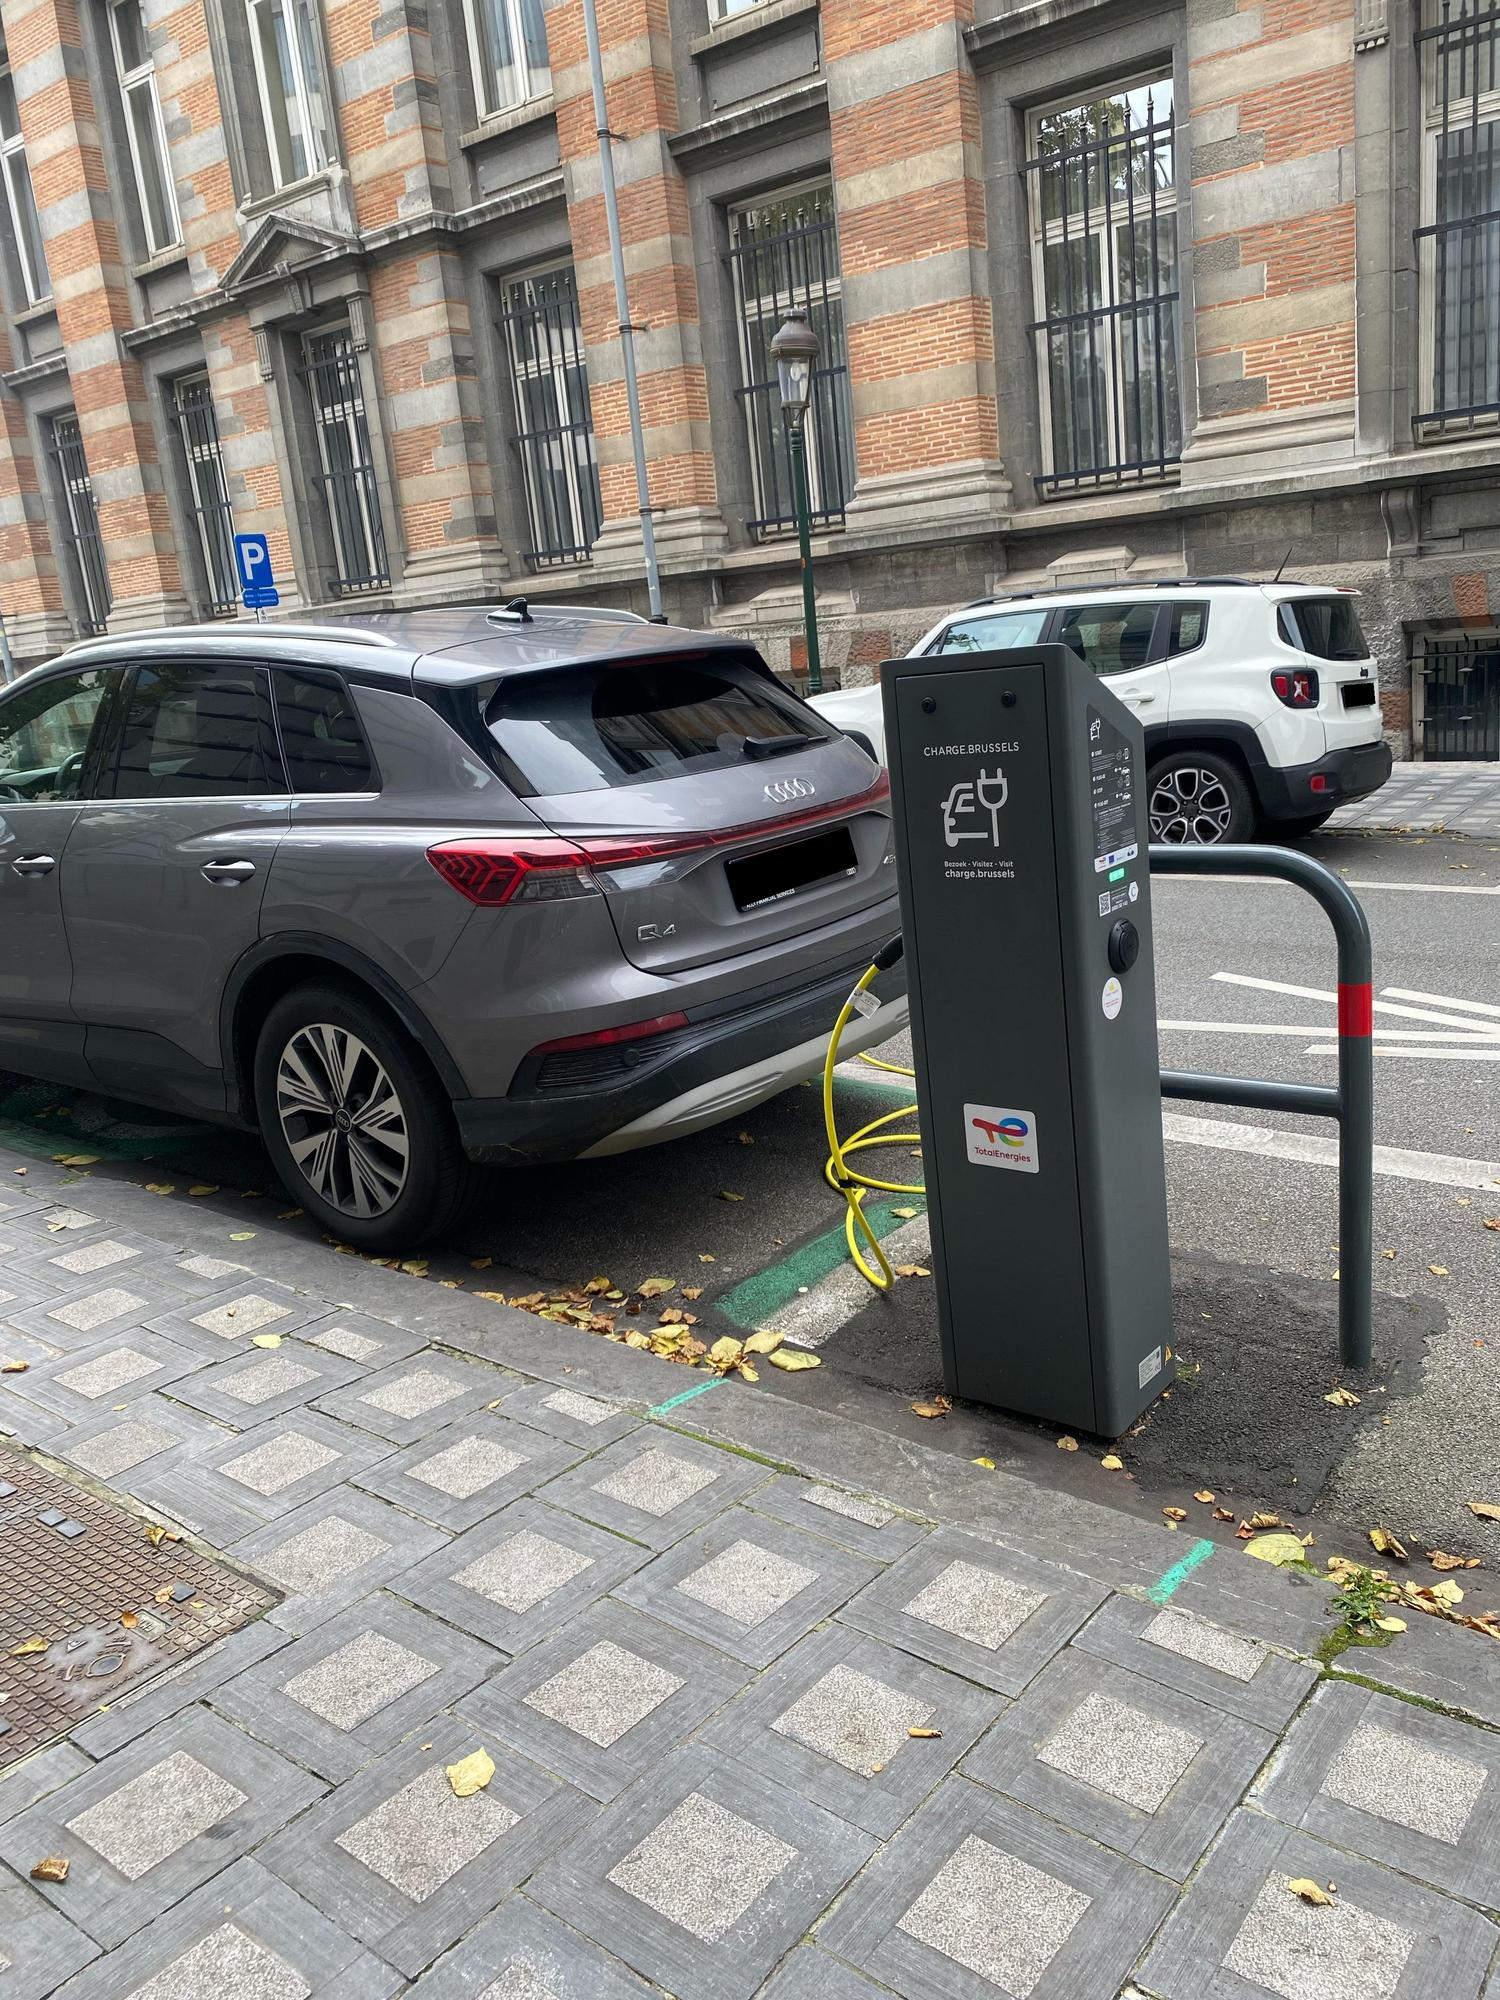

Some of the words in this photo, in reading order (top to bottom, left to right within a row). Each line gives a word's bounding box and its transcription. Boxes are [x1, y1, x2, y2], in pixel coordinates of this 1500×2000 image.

[241, 543, 264, 580] P
[923, 741, 1020, 757] CHARGE.BRUSSELS
[945, 869, 1015, 880] charge.brussels
[974, 1147, 1031, 1163] TotalEnergies
